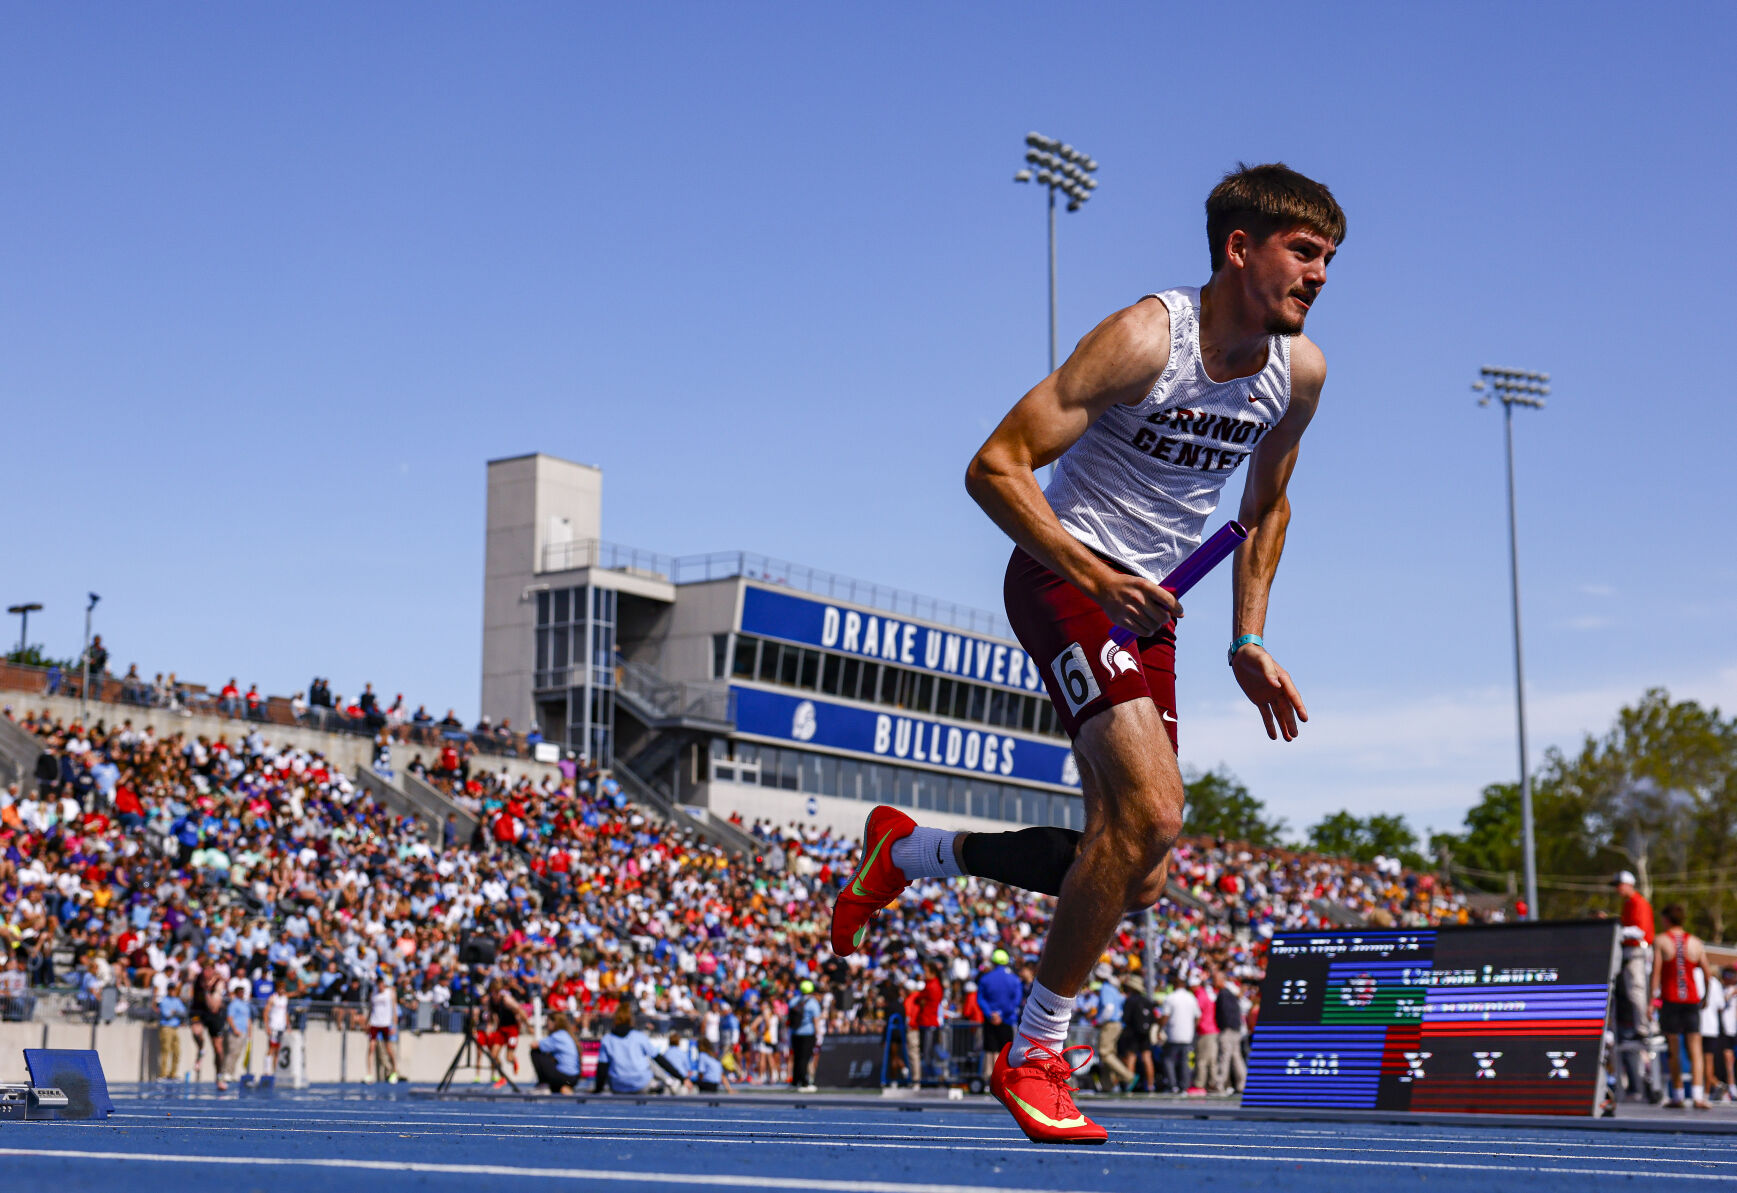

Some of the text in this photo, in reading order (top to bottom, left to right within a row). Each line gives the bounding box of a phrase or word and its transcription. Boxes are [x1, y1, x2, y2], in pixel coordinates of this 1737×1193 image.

[821, 606, 917, 664] DRAKE
[1060, 650, 1089, 705] 6
[873, 715, 1015, 775] BULLDOGS
[279, 1046, 291, 1069] 3
